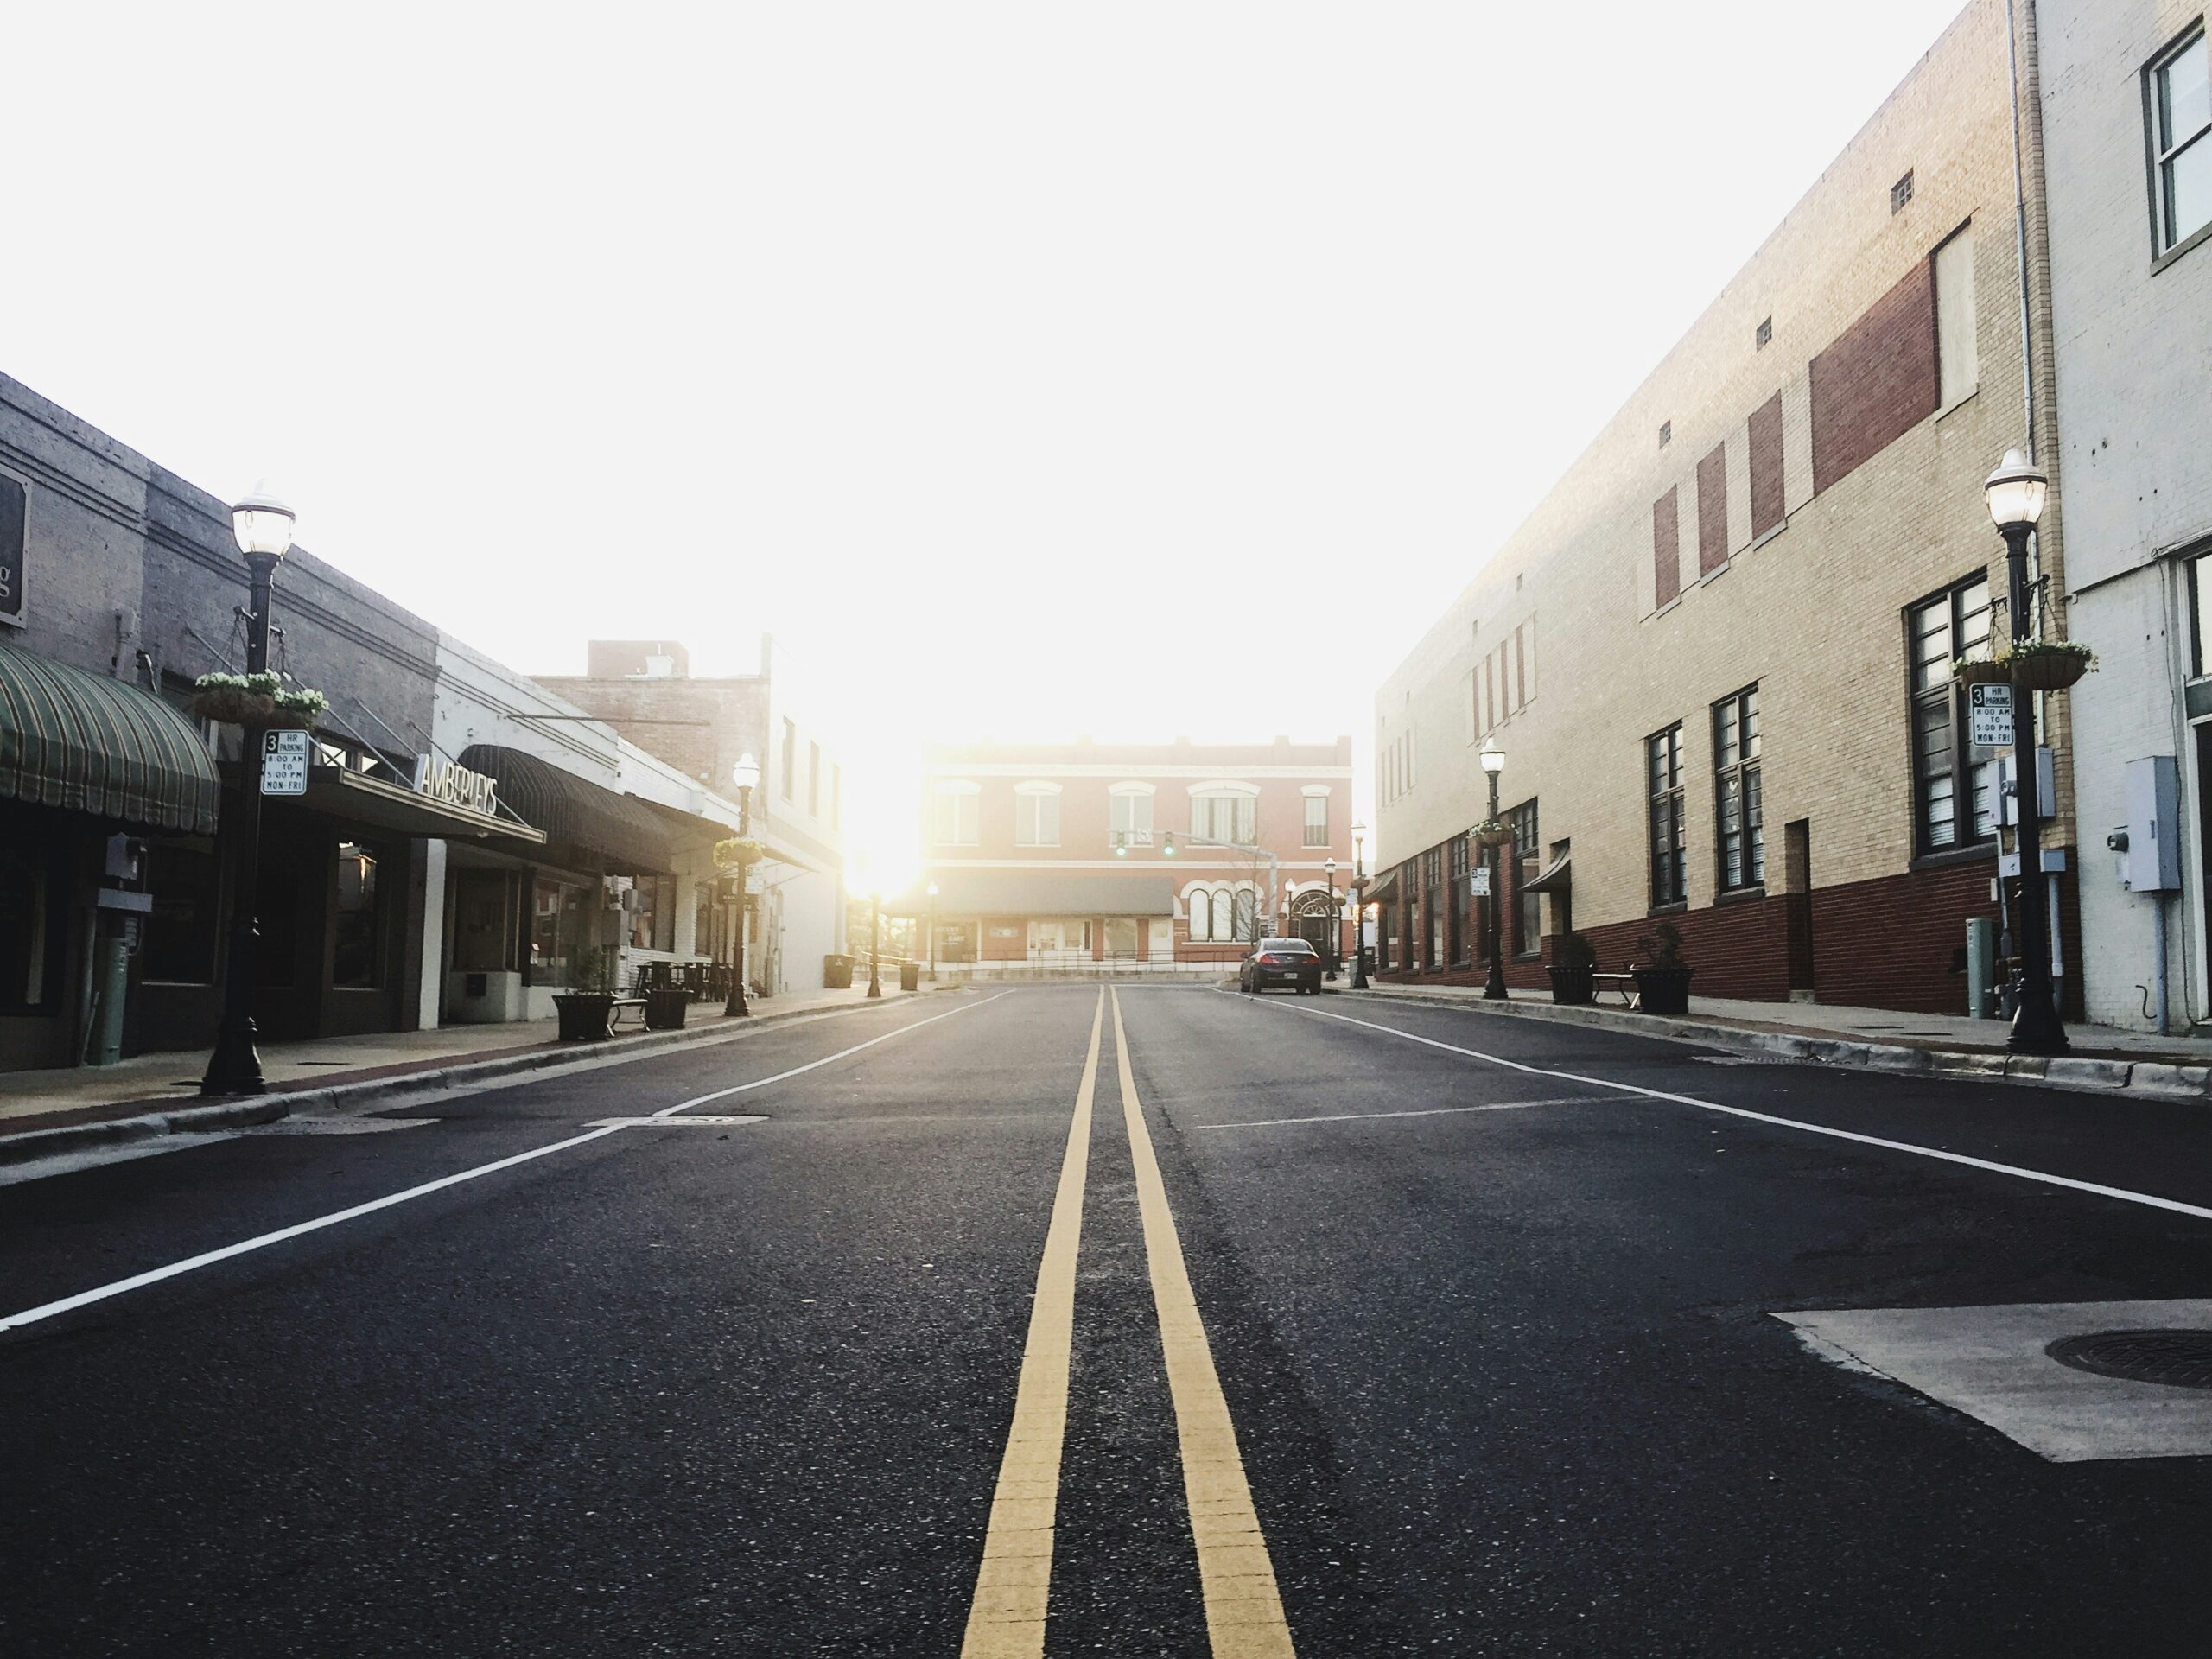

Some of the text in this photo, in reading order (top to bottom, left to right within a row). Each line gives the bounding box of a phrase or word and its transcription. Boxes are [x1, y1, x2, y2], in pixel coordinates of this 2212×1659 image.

[1992, 687, 2003, 696] HR
[1974, 689, 1983, 704] 3
[1986, 696, 2010, 705] PARKING
[286, 734, 298, 742] HR
[267, 735, 276, 751] 3
[279, 743, 304, 752] PARKING
